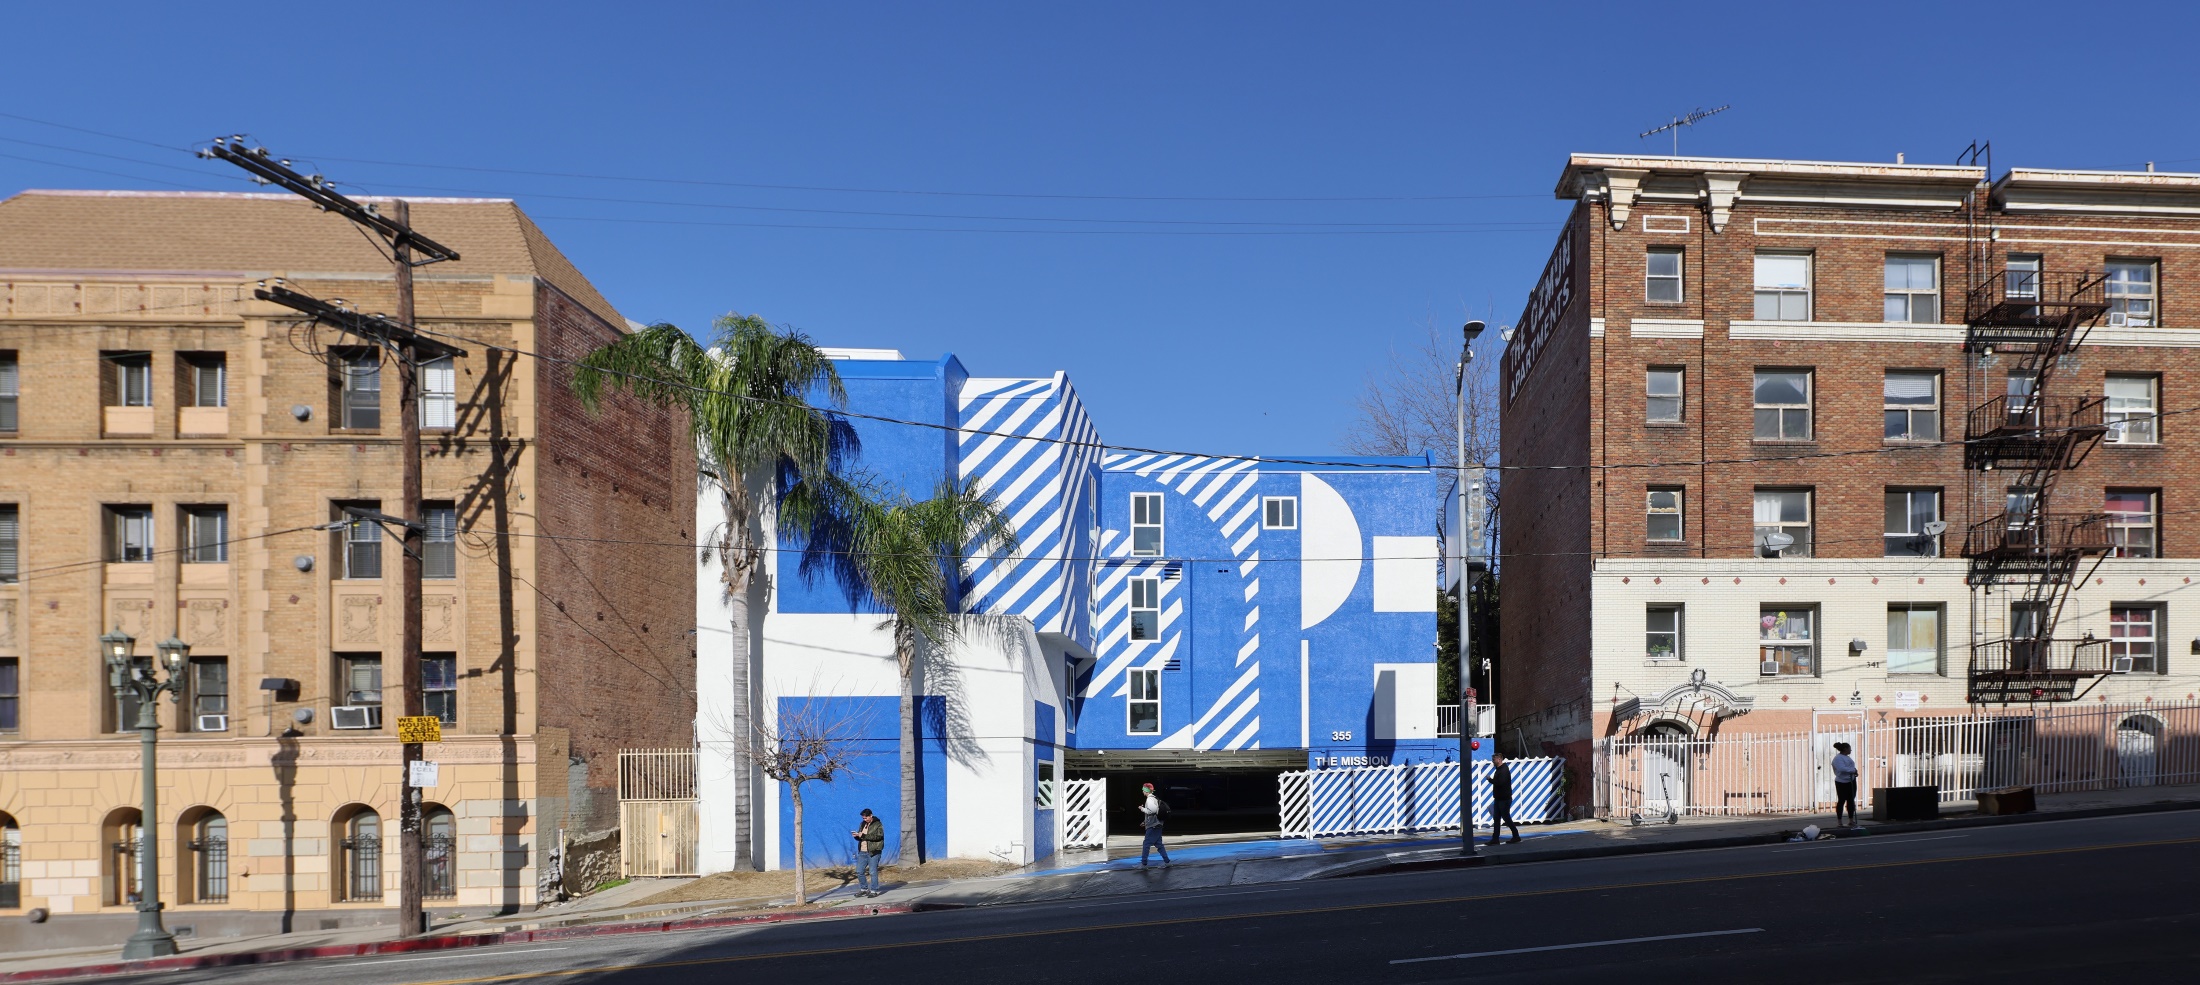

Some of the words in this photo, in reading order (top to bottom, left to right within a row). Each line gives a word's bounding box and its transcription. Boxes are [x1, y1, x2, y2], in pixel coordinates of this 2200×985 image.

[1509, 276, 1570, 404] APARTMENTS
[1509, 321, 1527, 372] THE
[1866, 661, 1880, 669] 341
[1332, 731, 1352, 741] 355
[1315, 756, 1338, 766] THE
[1341, 756, 1388, 766] MISSION
